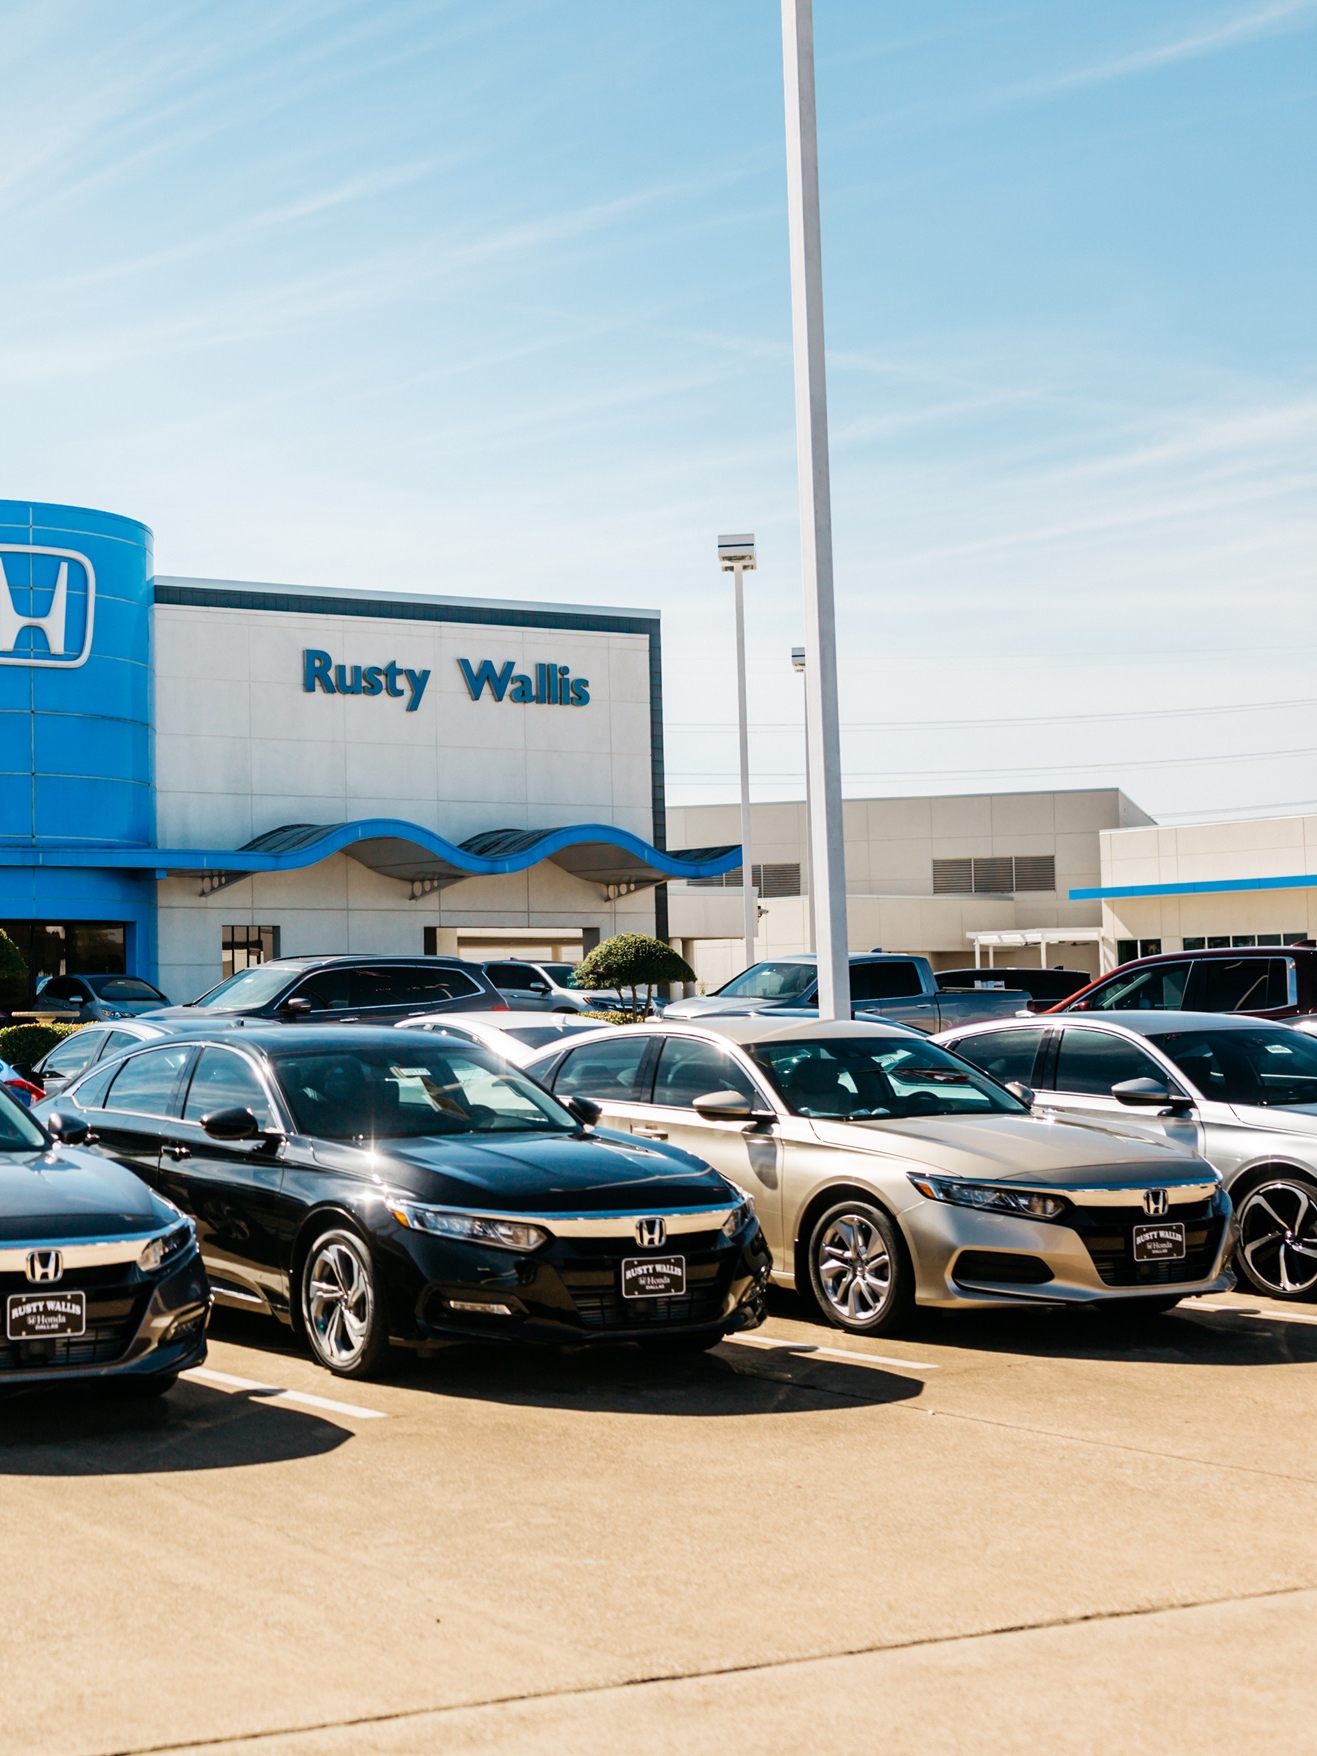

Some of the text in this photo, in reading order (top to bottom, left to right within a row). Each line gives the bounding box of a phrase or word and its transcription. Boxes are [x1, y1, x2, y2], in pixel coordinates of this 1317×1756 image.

[302, 649, 591, 712] Rusty Wallis
[1136, 1230, 1183, 1245] RUSTY WALLIS
[625, 1263, 682, 1280] RUSTY WALLIS
[647, 1275, 670, 1284] Honda
[11, 1300, 81, 1319] RUSTY WALLIS
[37, 1314, 66, 1325] Honda
